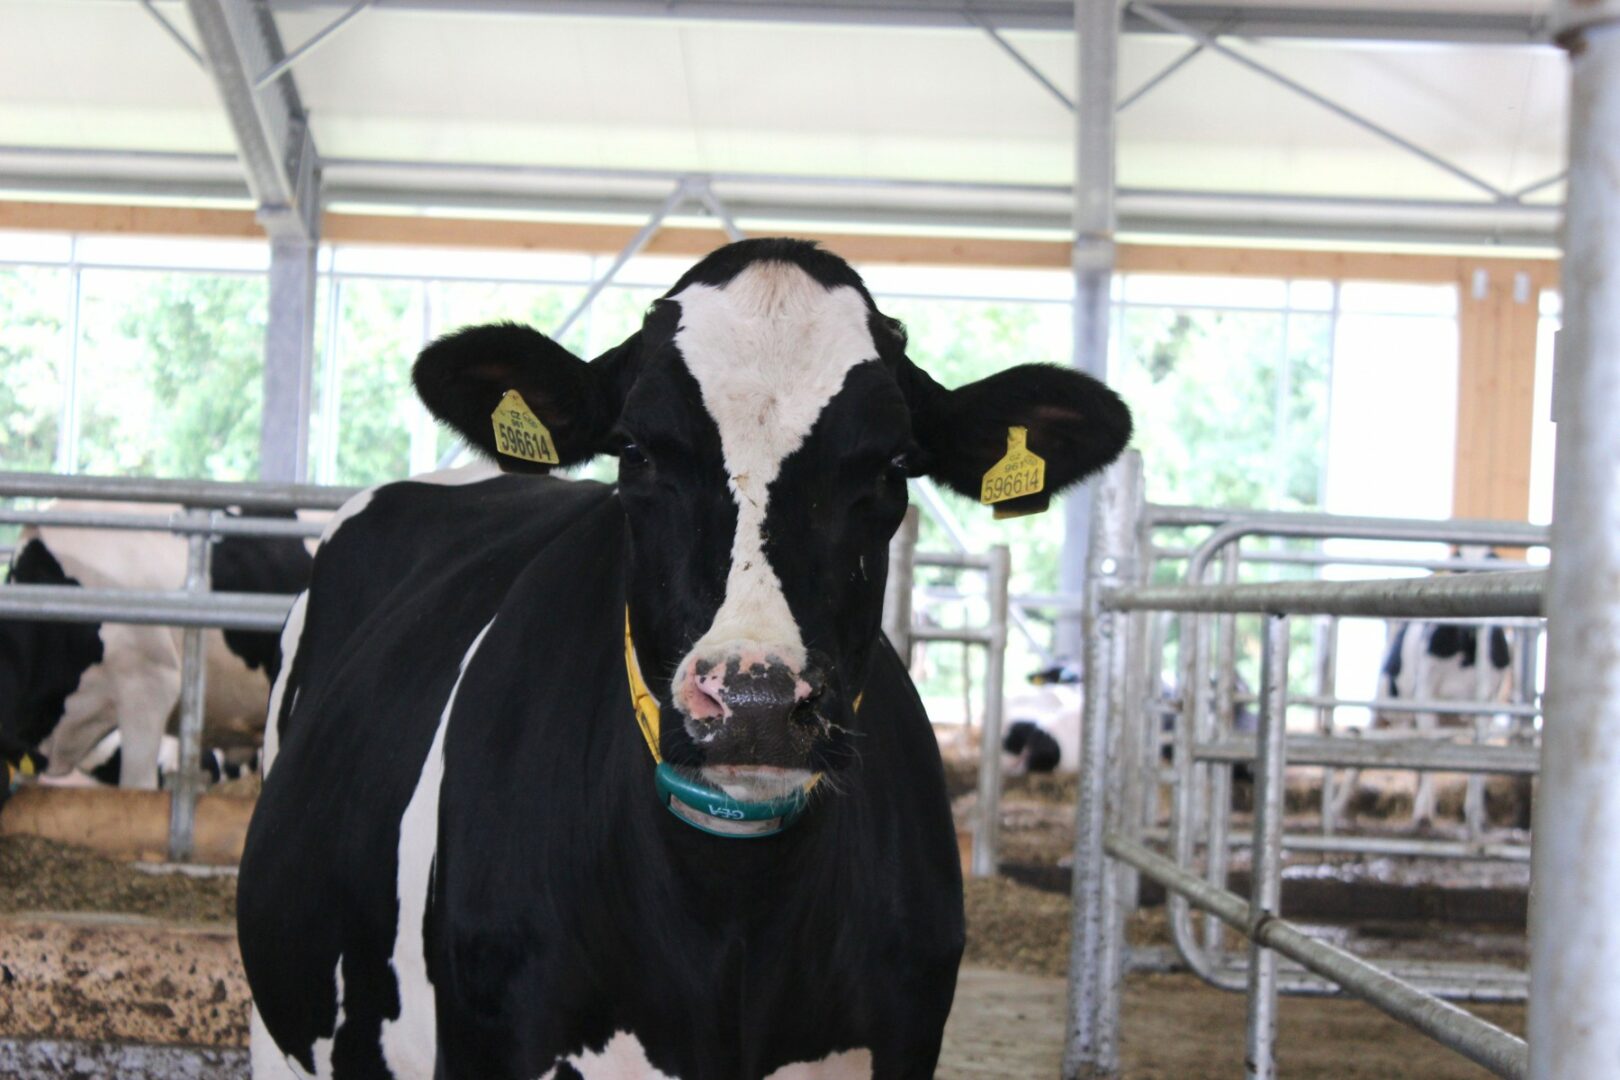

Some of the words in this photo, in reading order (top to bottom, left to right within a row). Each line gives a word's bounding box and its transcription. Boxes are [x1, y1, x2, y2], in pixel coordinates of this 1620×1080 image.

[499, 422, 551, 461] 596614
[983, 467, 1039, 502] 596614
[708, 804, 745, 820] GEA
